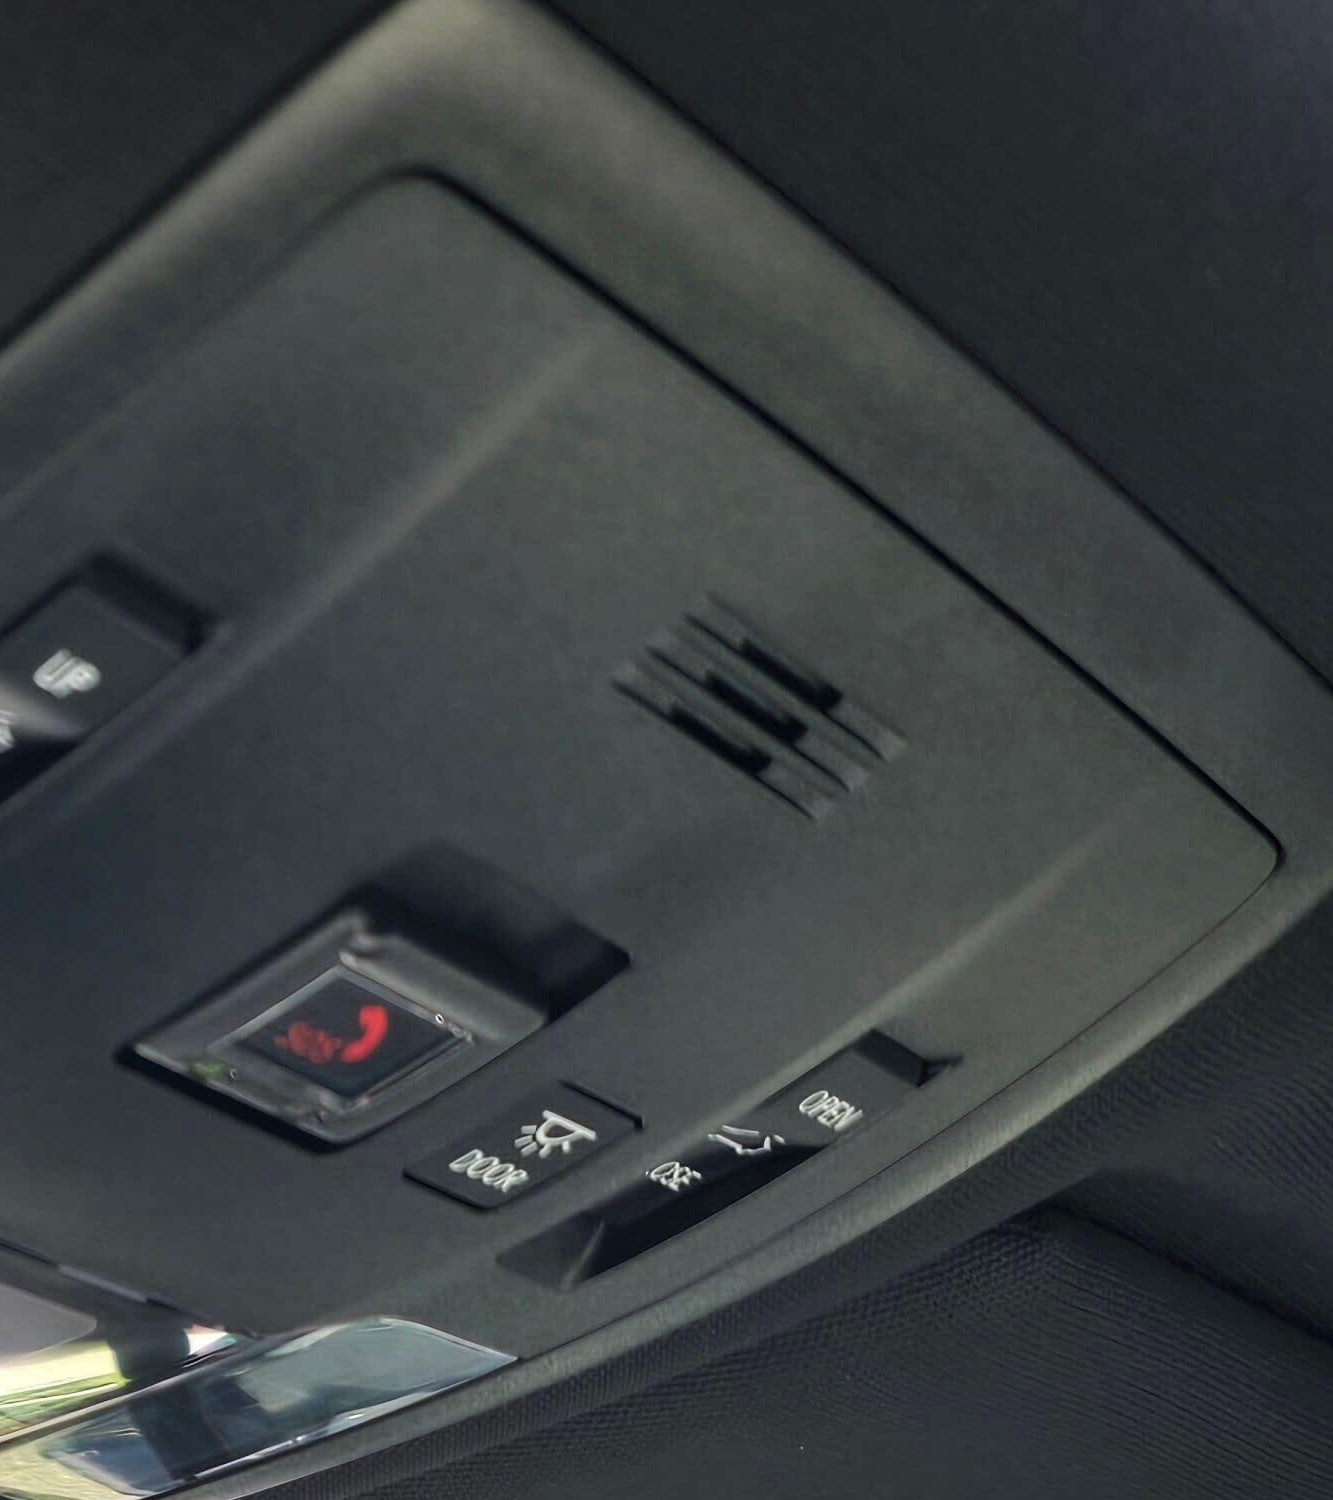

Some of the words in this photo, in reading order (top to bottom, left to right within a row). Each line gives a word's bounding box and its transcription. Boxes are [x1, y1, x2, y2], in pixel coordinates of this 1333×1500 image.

[34, 648, 101, 698] UP
[799, 1090, 863, 1132] OPEN
[449, 1148, 528, 1192] DOOR
